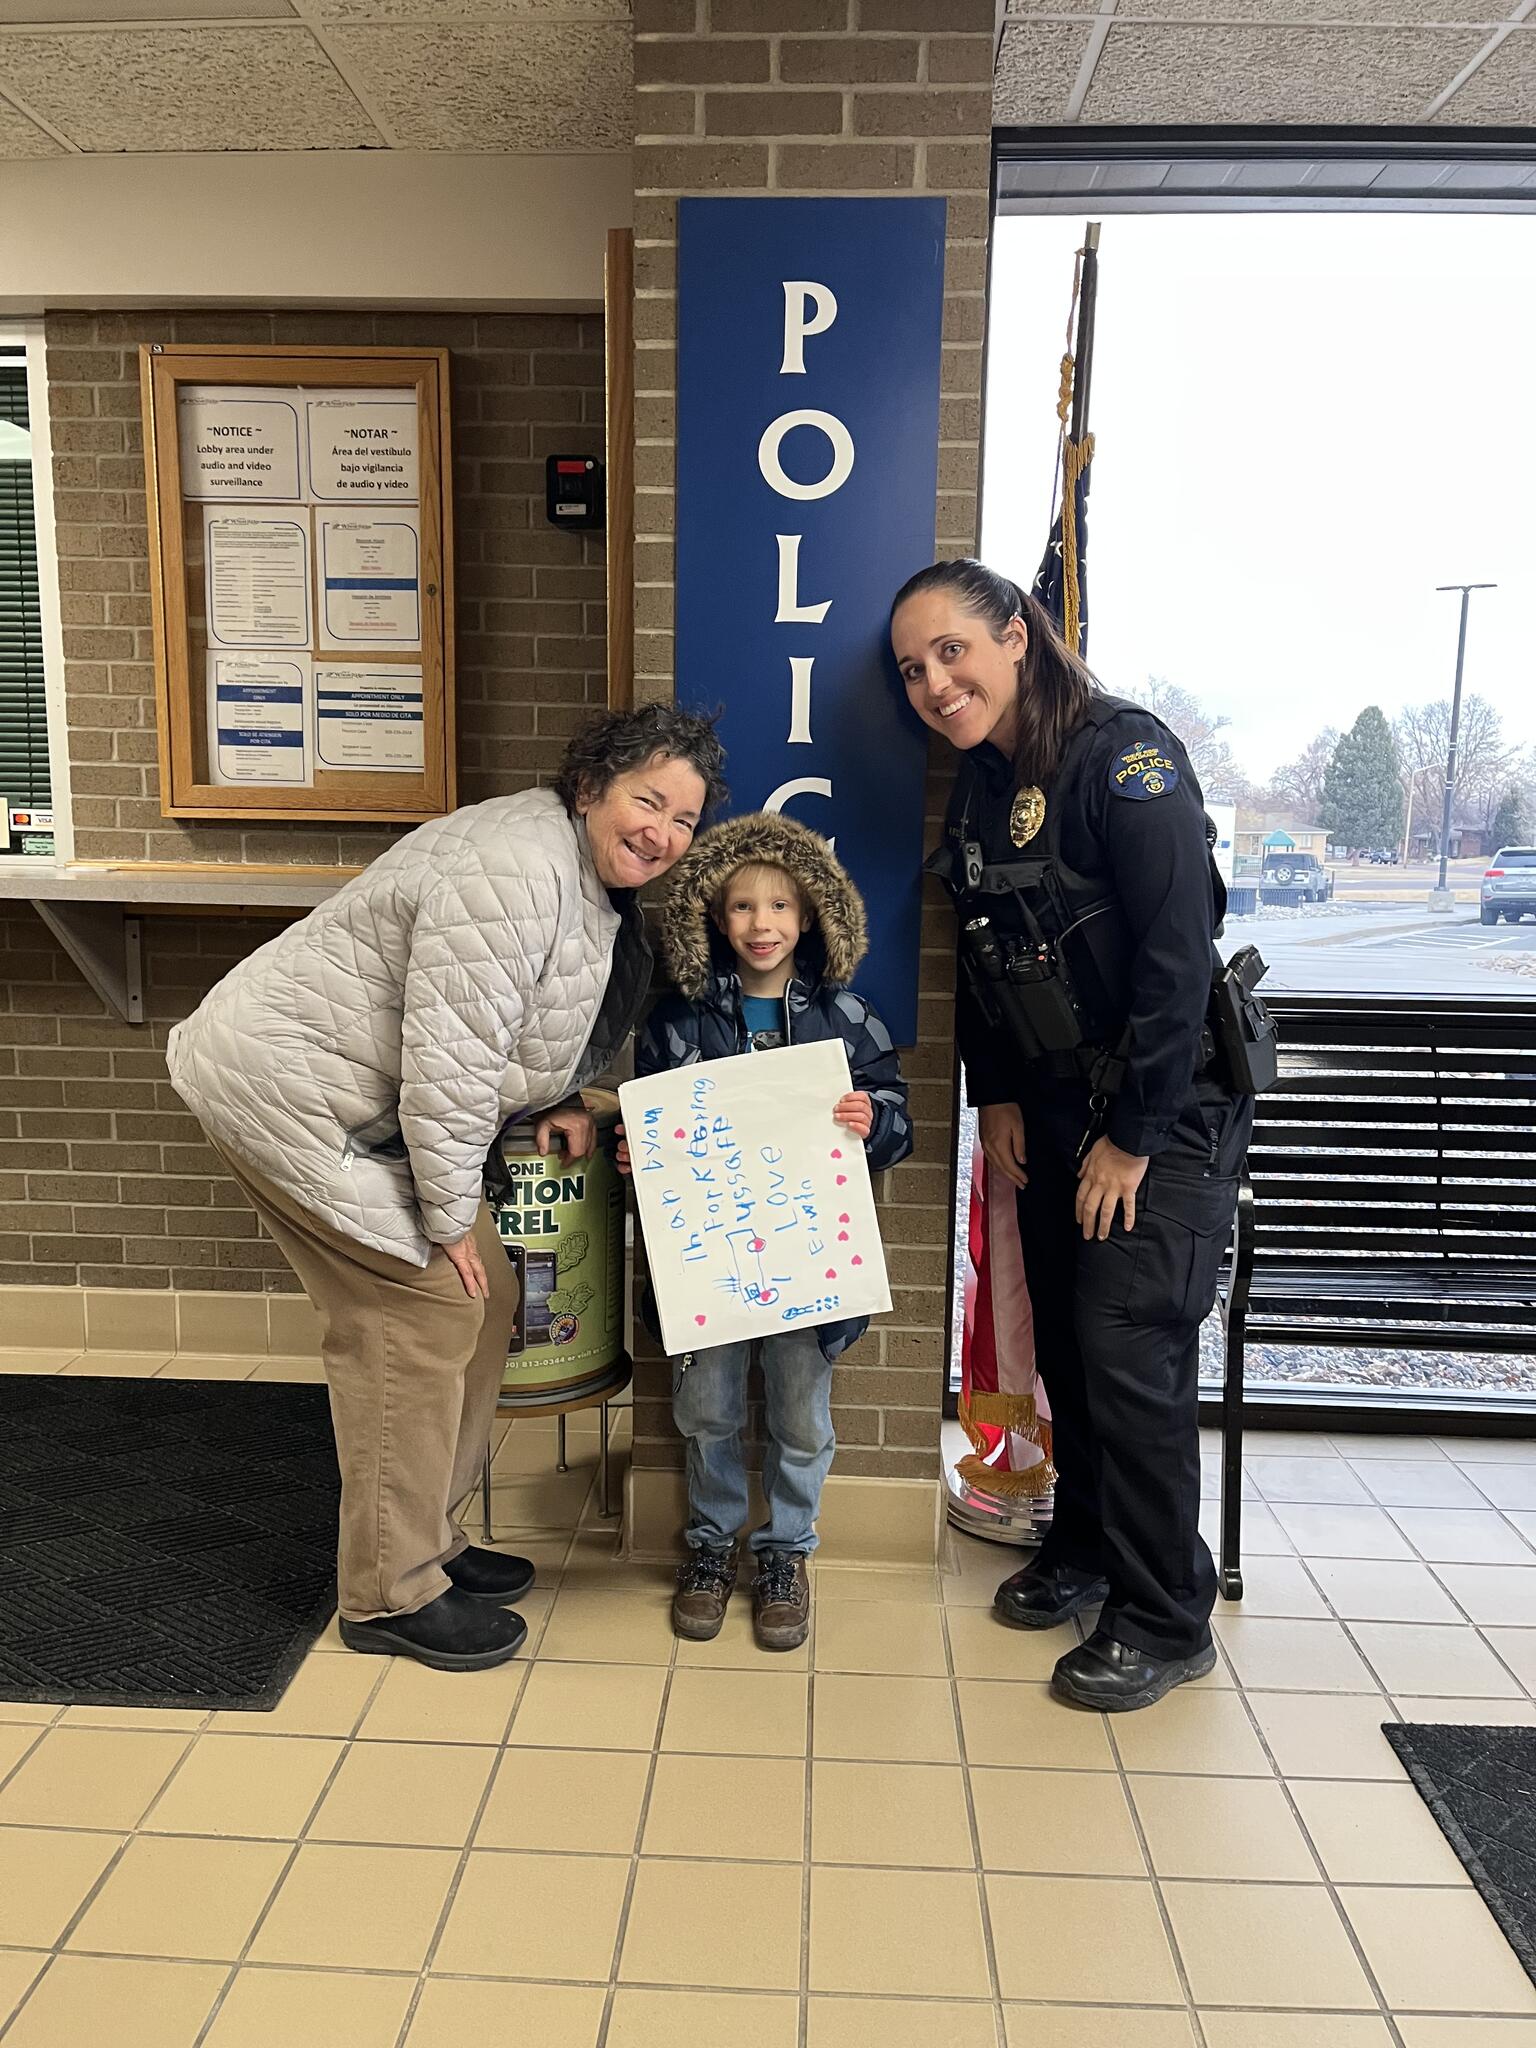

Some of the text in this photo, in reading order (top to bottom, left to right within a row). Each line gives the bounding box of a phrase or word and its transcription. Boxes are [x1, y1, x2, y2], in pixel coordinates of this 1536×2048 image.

[197, 445, 274, 455] Lobby area under
[354, 447, 369, 456] del
[200, 460, 272, 471] audio and video
[340, 463, 404, 474] bajo vigilancia
[210, 477, 263, 487] surveillance
[336, 479, 409, 490] de audio y video
[1115, 757, 1174, 784] POLICE
[508, 1162, 544, 1176] ONE
